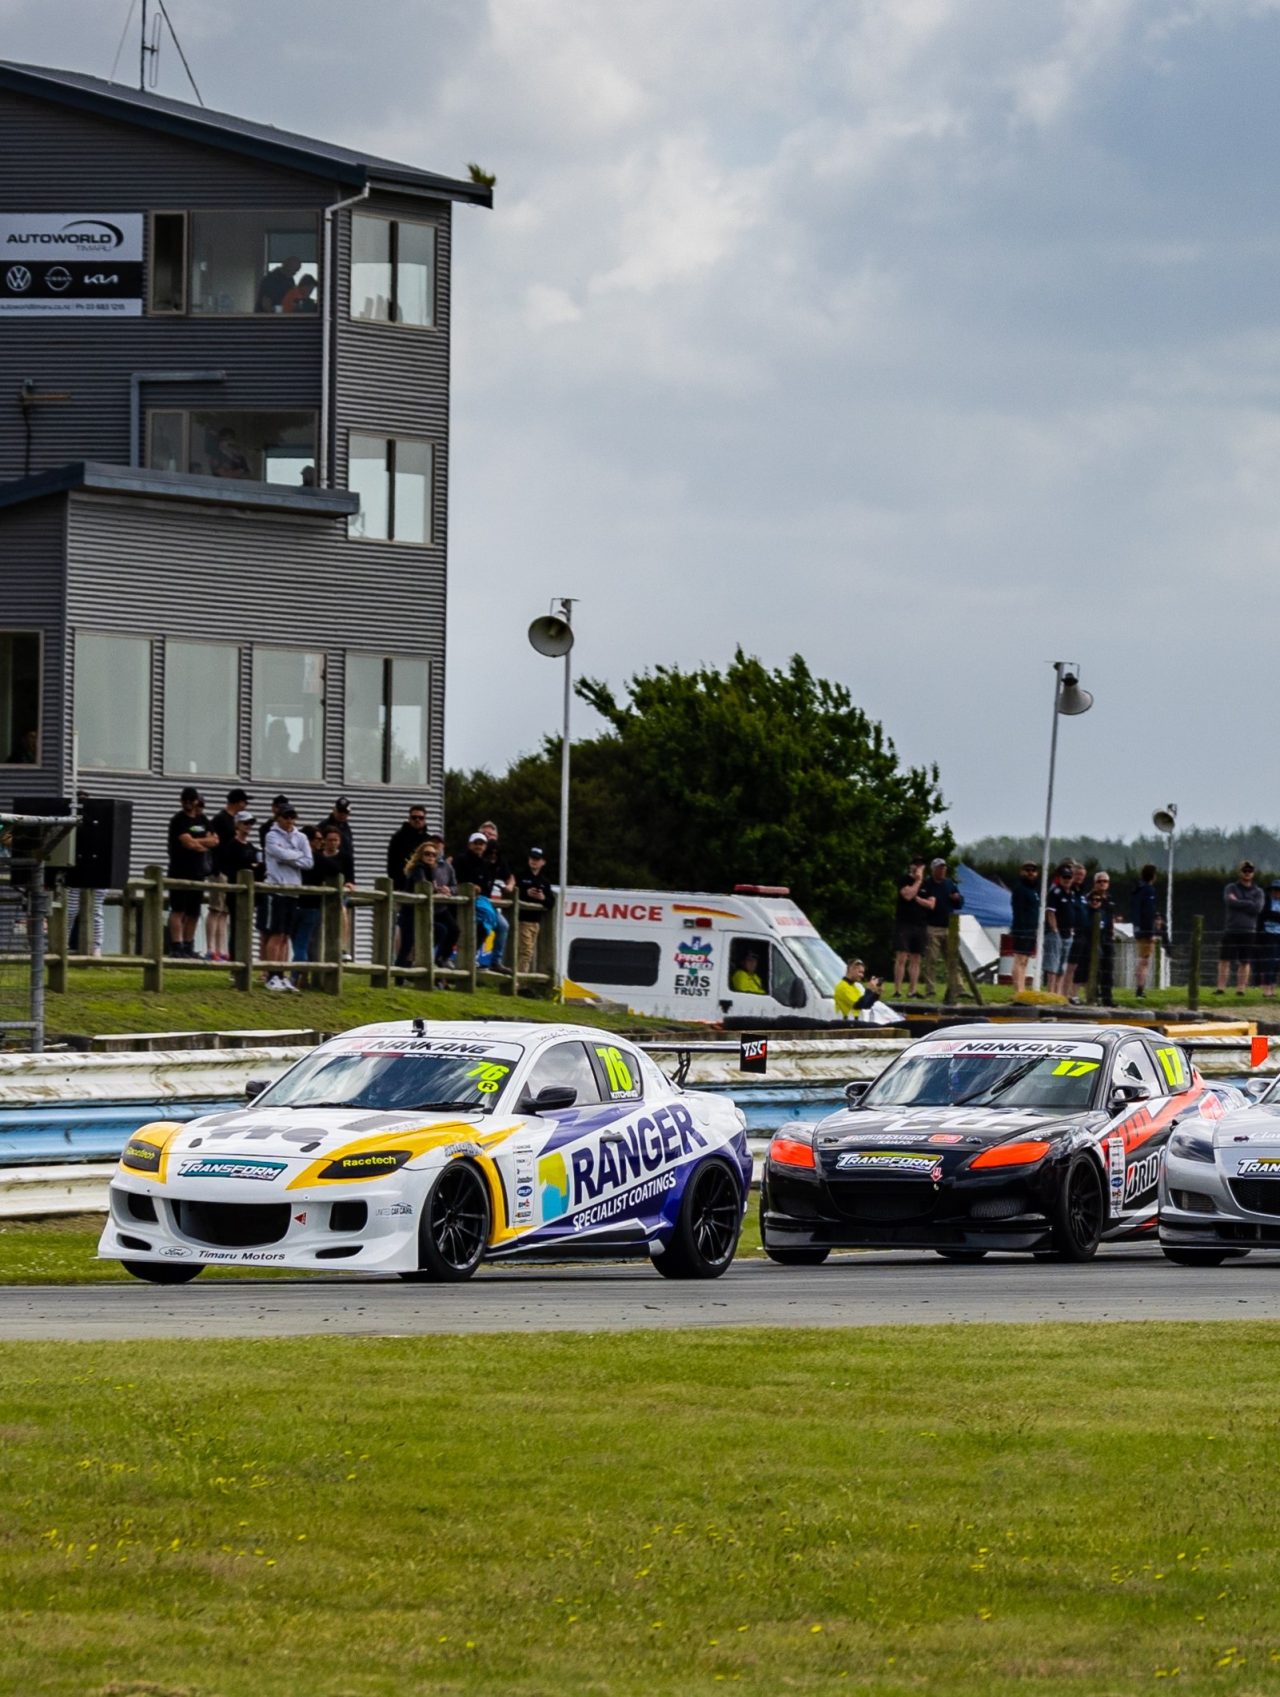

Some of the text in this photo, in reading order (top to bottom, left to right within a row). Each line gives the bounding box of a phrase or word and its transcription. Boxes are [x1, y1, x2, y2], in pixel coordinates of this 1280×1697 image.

[6, 233, 112, 244] AUTOWORLD
[675, 974, 710, 988] EMS
[674, 986, 710, 997] TRUST
[369, 1040, 496, 1054] NANKANG
[959, 1042, 1079, 1054] NANKANG
[465, 1061, 510, 1080] 76
[595, 1047, 632, 1092] 76
[1051, 1060, 1101, 1077] 17
[1155, 1046, 1185, 1087] 17
[343, 1155, 397, 1168] Racetech
[571, 1103, 709, 1206] RANGER
[838, 1153, 937, 1170] TRANSFORM
[180, 1159, 283, 1179] TRANSFORM
[1125, 1145, 1166, 1203] BRID
[573, 1170, 677, 1232] SPECIALIST COATINGS
[198, 1250, 286, 1261] Timaru Motors
